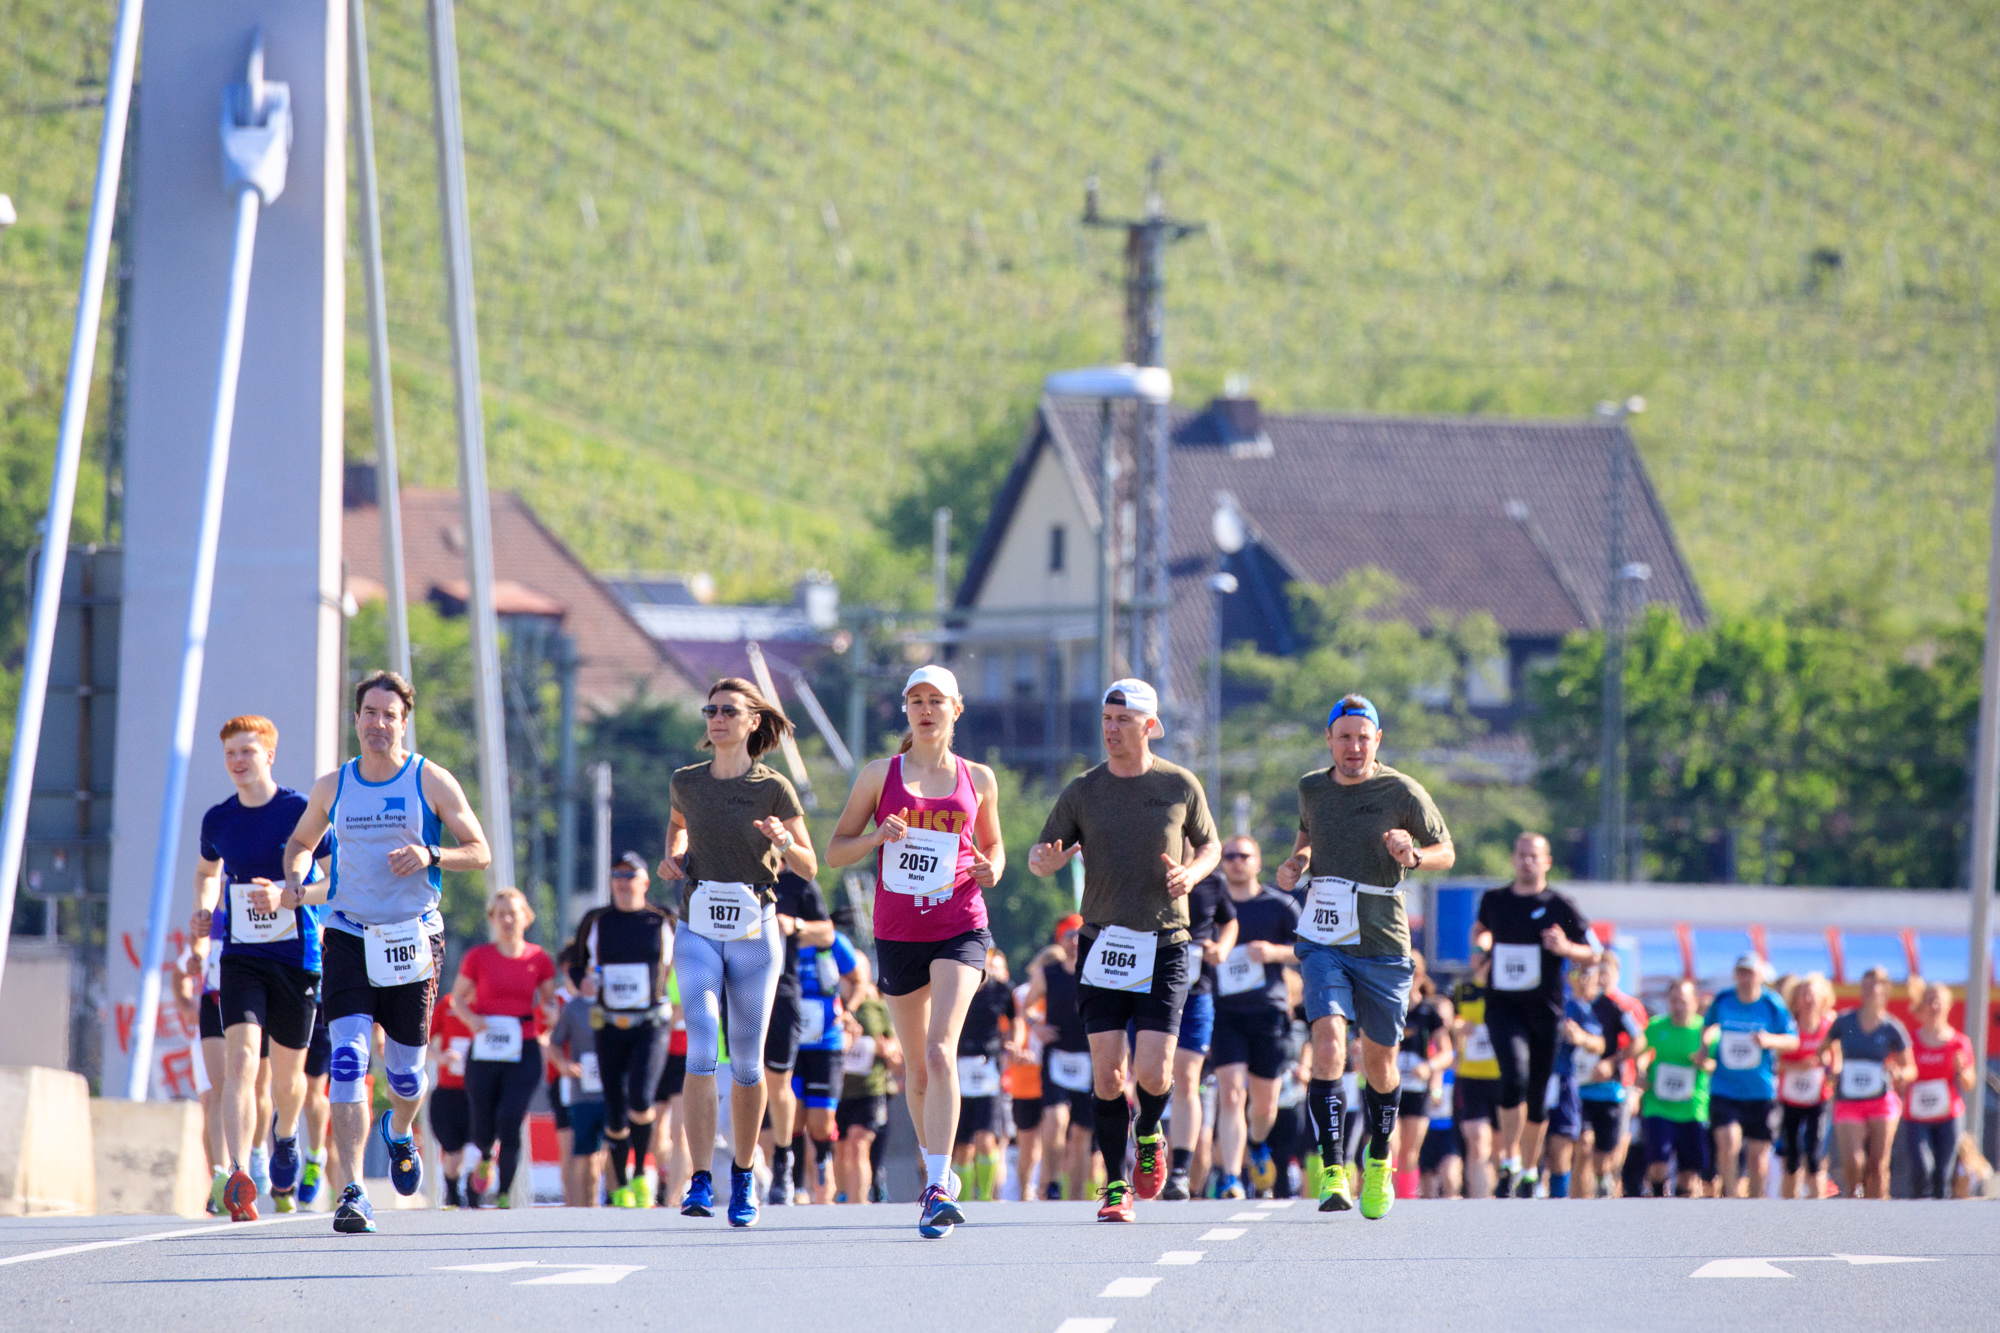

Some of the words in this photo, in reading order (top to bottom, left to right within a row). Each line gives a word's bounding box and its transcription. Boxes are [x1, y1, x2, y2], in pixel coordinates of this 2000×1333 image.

[345, 815, 373, 823] Knoesel
[375, 814, 382, 822] &
[385, 813, 407, 822] Ronge
[905, 809, 968, 834] UST
[905, 844, 935, 852] Halbmarathon
[899, 852, 939, 873] 2057
[908, 873, 925, 881] Marie
[709, 896, 740, 904] Halbmarathon
[708, 905, 741, 922] 1877
[1313, 908, 1340, 925] 1875
[713, 922, 736, 930] Claudia
[1105, 941, 1136, 950] Halbmarathon
[383, 944, 417, 963] 1180
[1100, 949, 1137, 969] 1864
[394, 963, 412, 972] Ulrich
[1104, 967, 1129, 977] Wolfram
